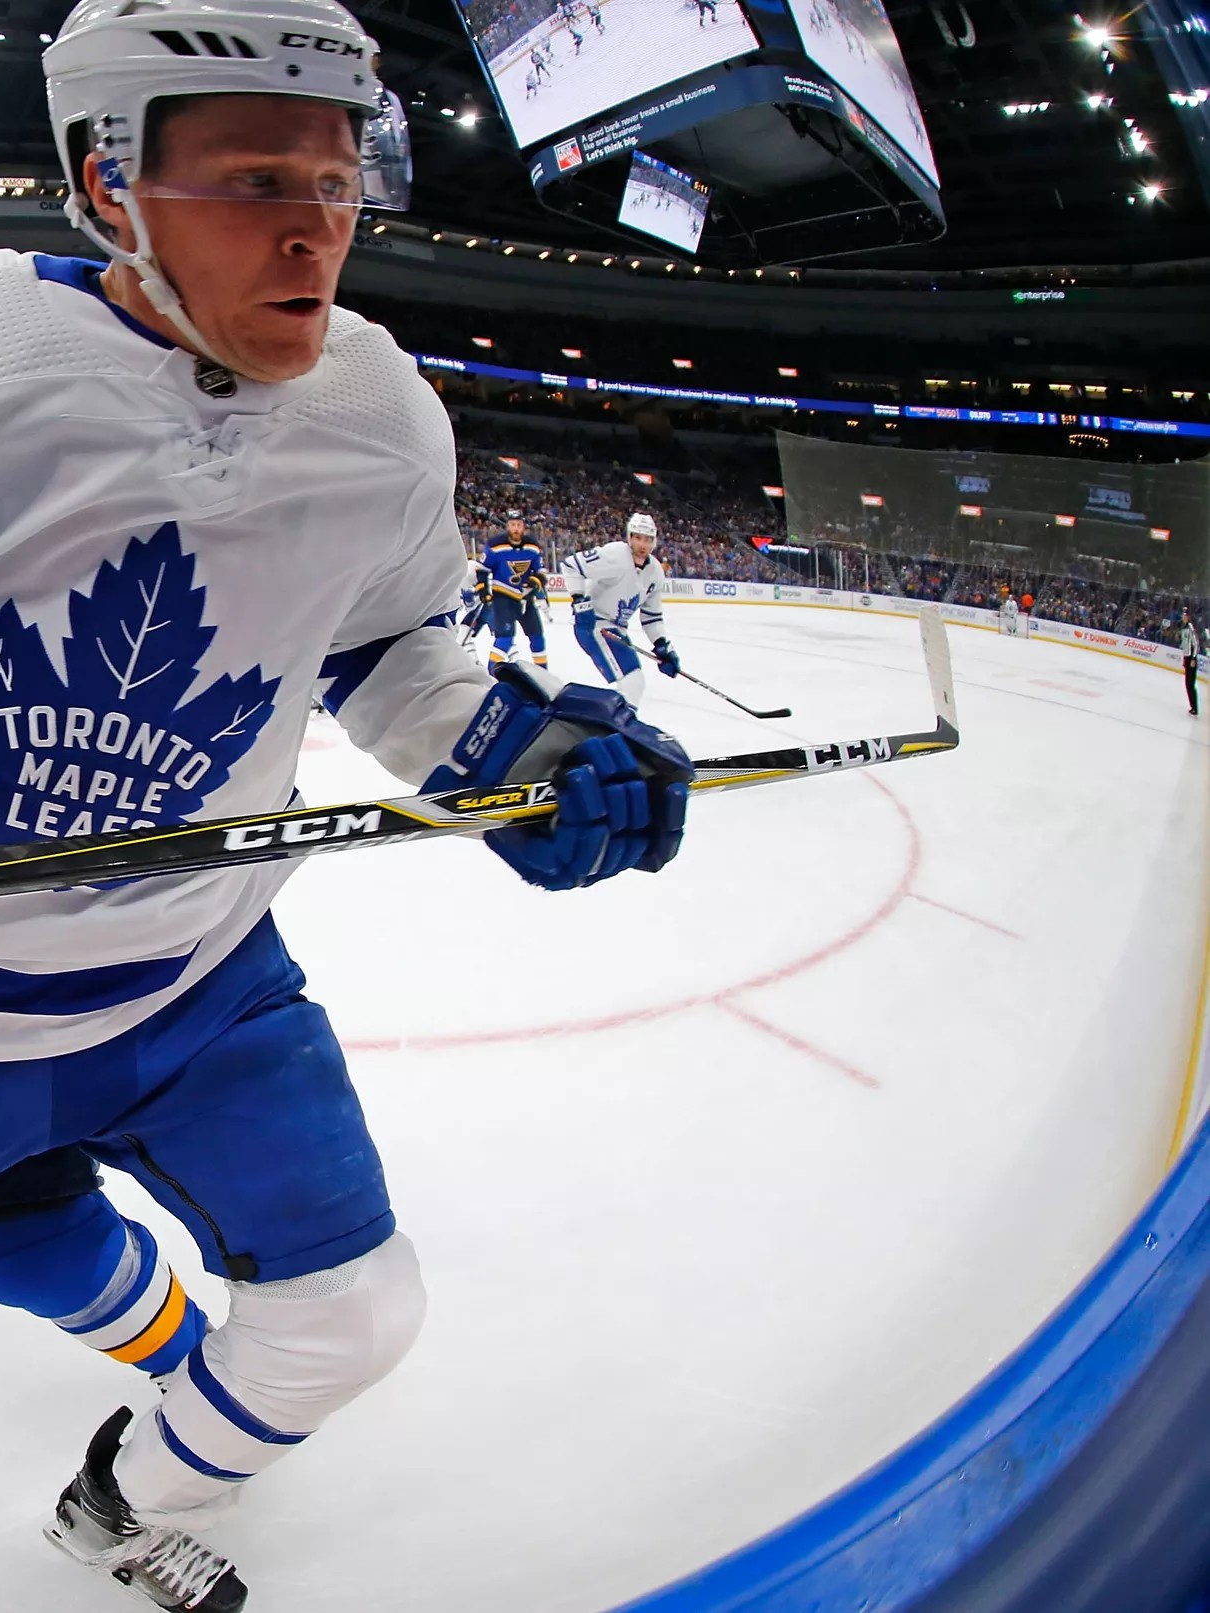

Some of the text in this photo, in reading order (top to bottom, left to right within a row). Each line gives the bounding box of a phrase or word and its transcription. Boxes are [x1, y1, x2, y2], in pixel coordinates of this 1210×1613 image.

[279, 32, 364, 59] CCM
[586, 136, 639, 161] Let's think big.
[704, 583, 737, 596] GEICO
[464, 696, 503, 755] CCM
[800, 737, 891, 772] CCM
[18, 752, 171, 814] MAPLE
[6, 793, 156, 838] LEAF
[456, 792, 524, 810] SUPER
[223, 810, 383, 851] CCM
